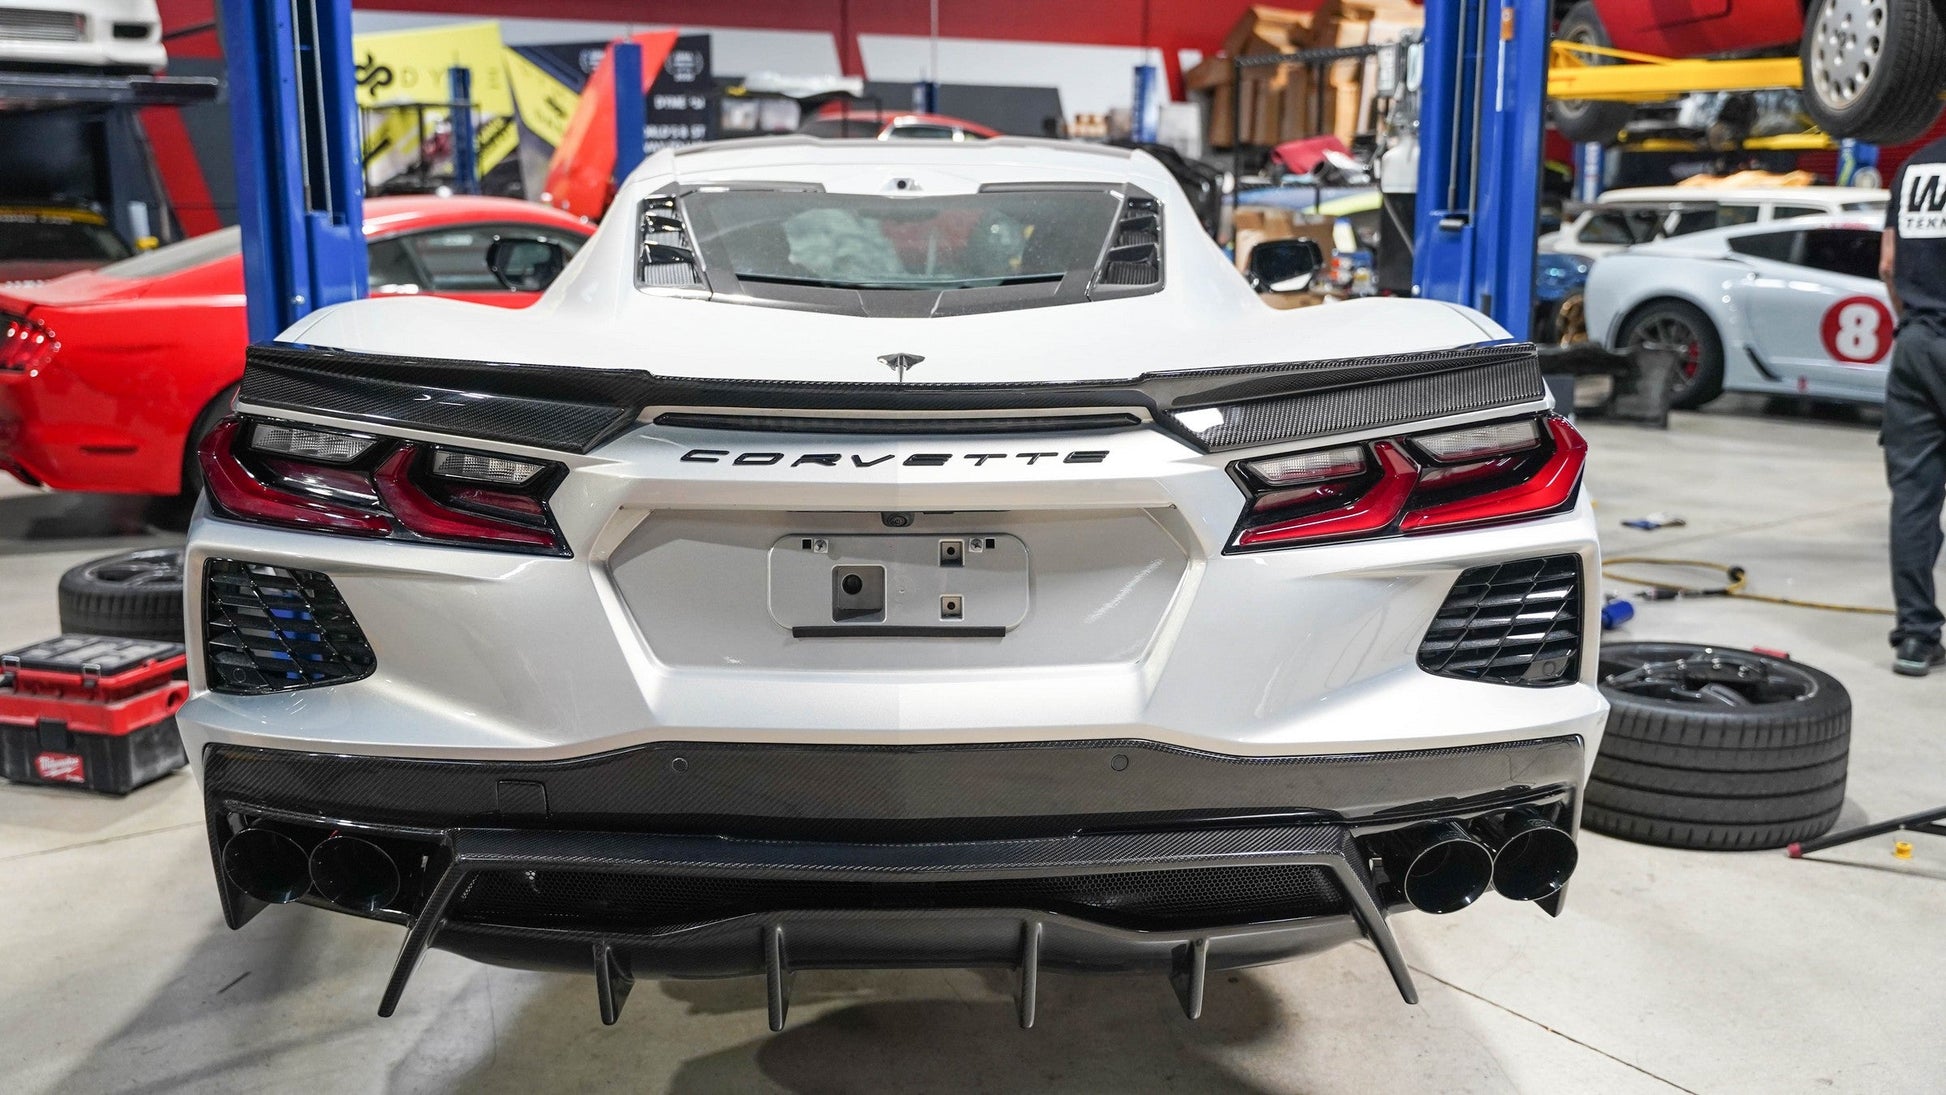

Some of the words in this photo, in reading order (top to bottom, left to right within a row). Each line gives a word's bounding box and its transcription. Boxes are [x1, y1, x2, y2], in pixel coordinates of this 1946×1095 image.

[401, 66, 499, 89] DYE
[1835, 303, 1881, 360] 8
[680, 449, 1110, 468] CORVETTE
